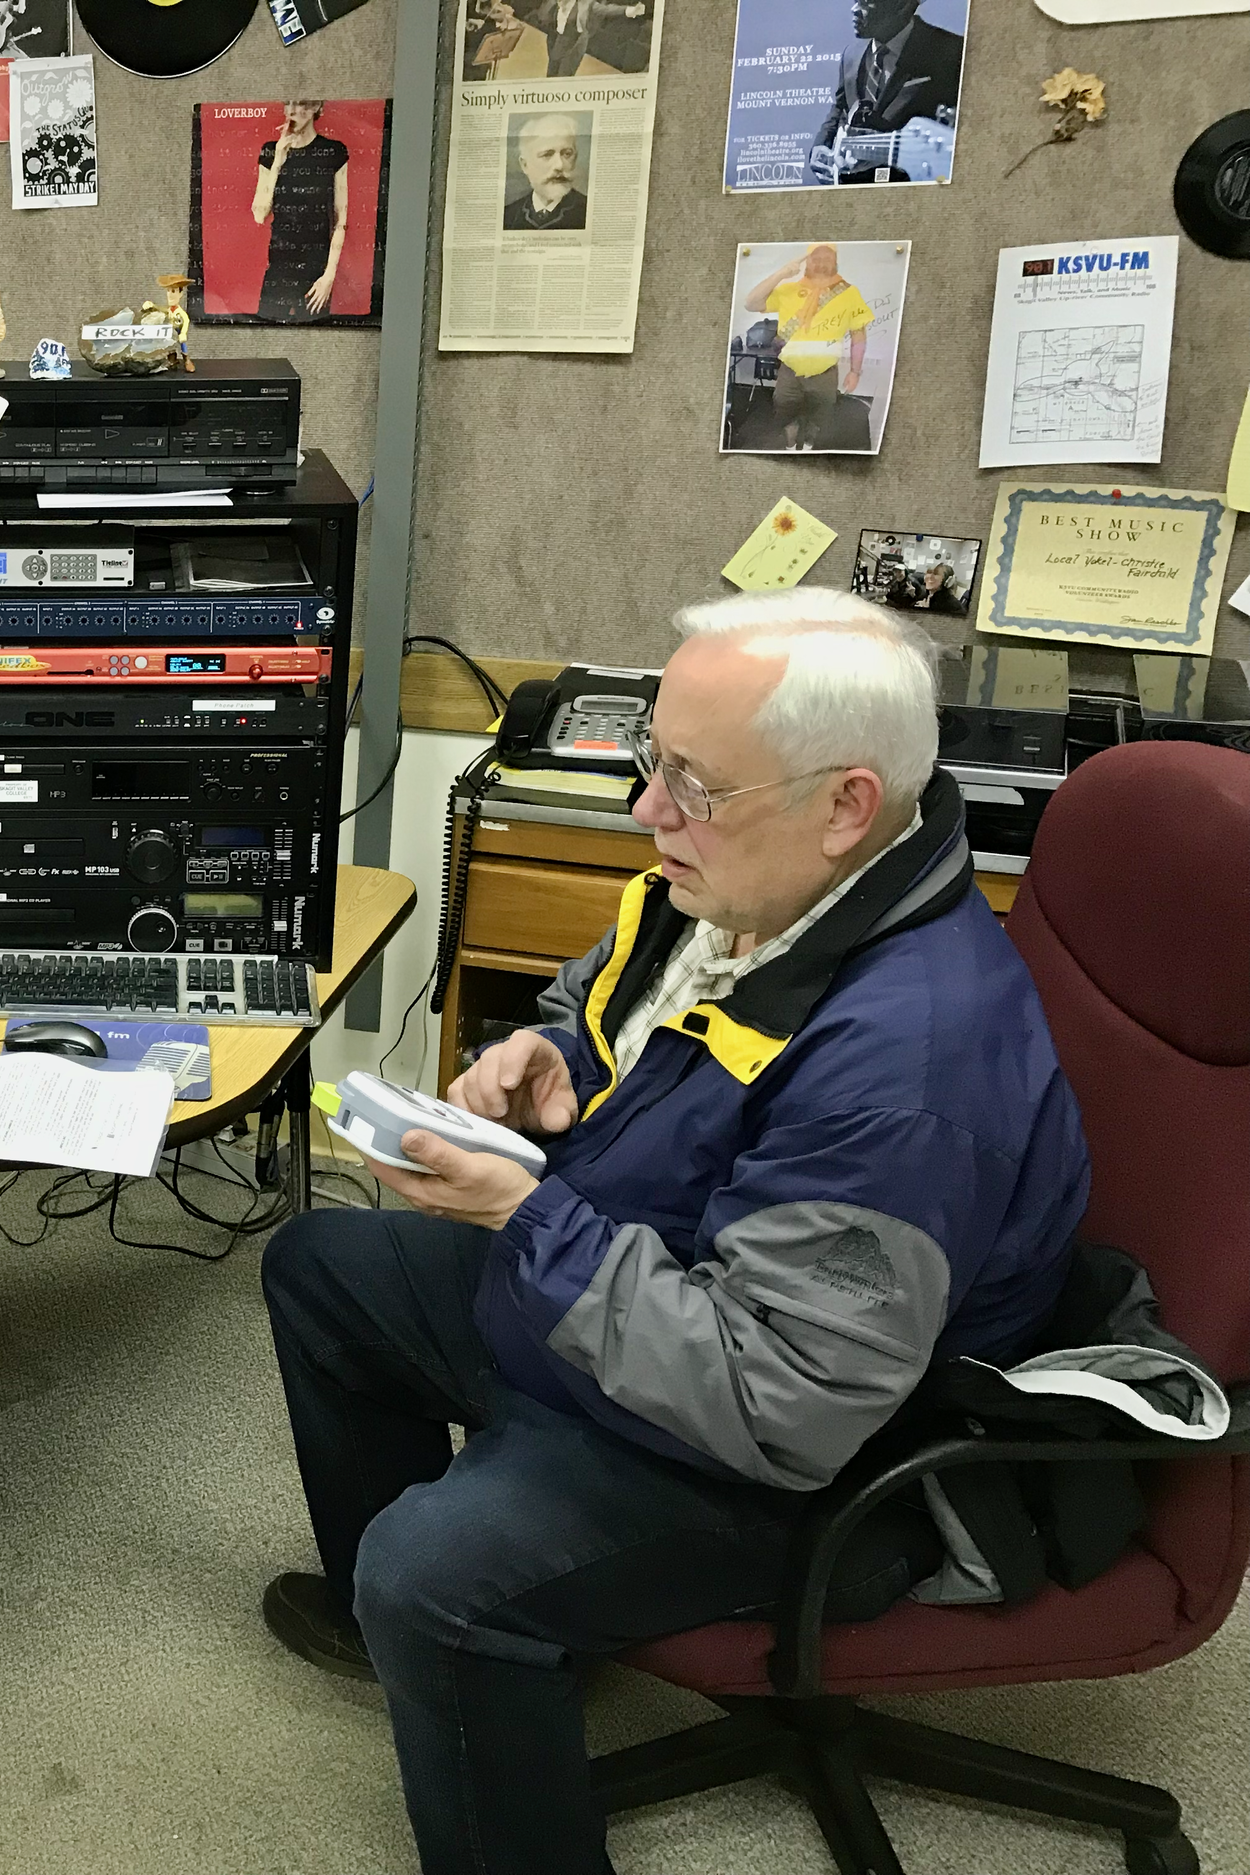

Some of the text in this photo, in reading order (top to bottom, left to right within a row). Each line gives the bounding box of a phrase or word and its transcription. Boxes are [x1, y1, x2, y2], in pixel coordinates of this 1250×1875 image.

[766, 45, 813, 56] SUNDAY
[737, 55, 798, 67] FEBRUARY
[816, 53, 842, 62] 2015
[767, 63, 808, 74] 7:30PM
[21, 71, 72, 106] Outgrow
[741, 87, 832, 100] LINCOLN THEATRE
[461, 87, 648, 110] Simply virtuoso composer
[736, 96, 834, 109] MOUNT VERNON WA
[215, 108, 267, 118] LOVERBOY
[36, 116, 81, 136] THE STATUS
[747, 134, 779, 142] TICKETS
[740, 147, 804, 156] lincolntheatre.org
[737, 163, 803, 182] LINCOLN
[25, 183, 58, 196] STRIKE!
[1025, 251, 1149, 275] 90.1 KSVU-FM
[812, 309, 847, 336] TREY
[95, 327, 173, 338] ROCK IT
[1040, 515, 1184, 533] BEST MUSIC
[1076, 529, 1142, 542] SHOW
[1045, 553, 1080, 564] Local
[25, 711, 115, 727] ONE
[310, 833, 321, 874] Numark
[292, 896, 306, 950] Numark
[107, 1031, 130, 1039] fm
